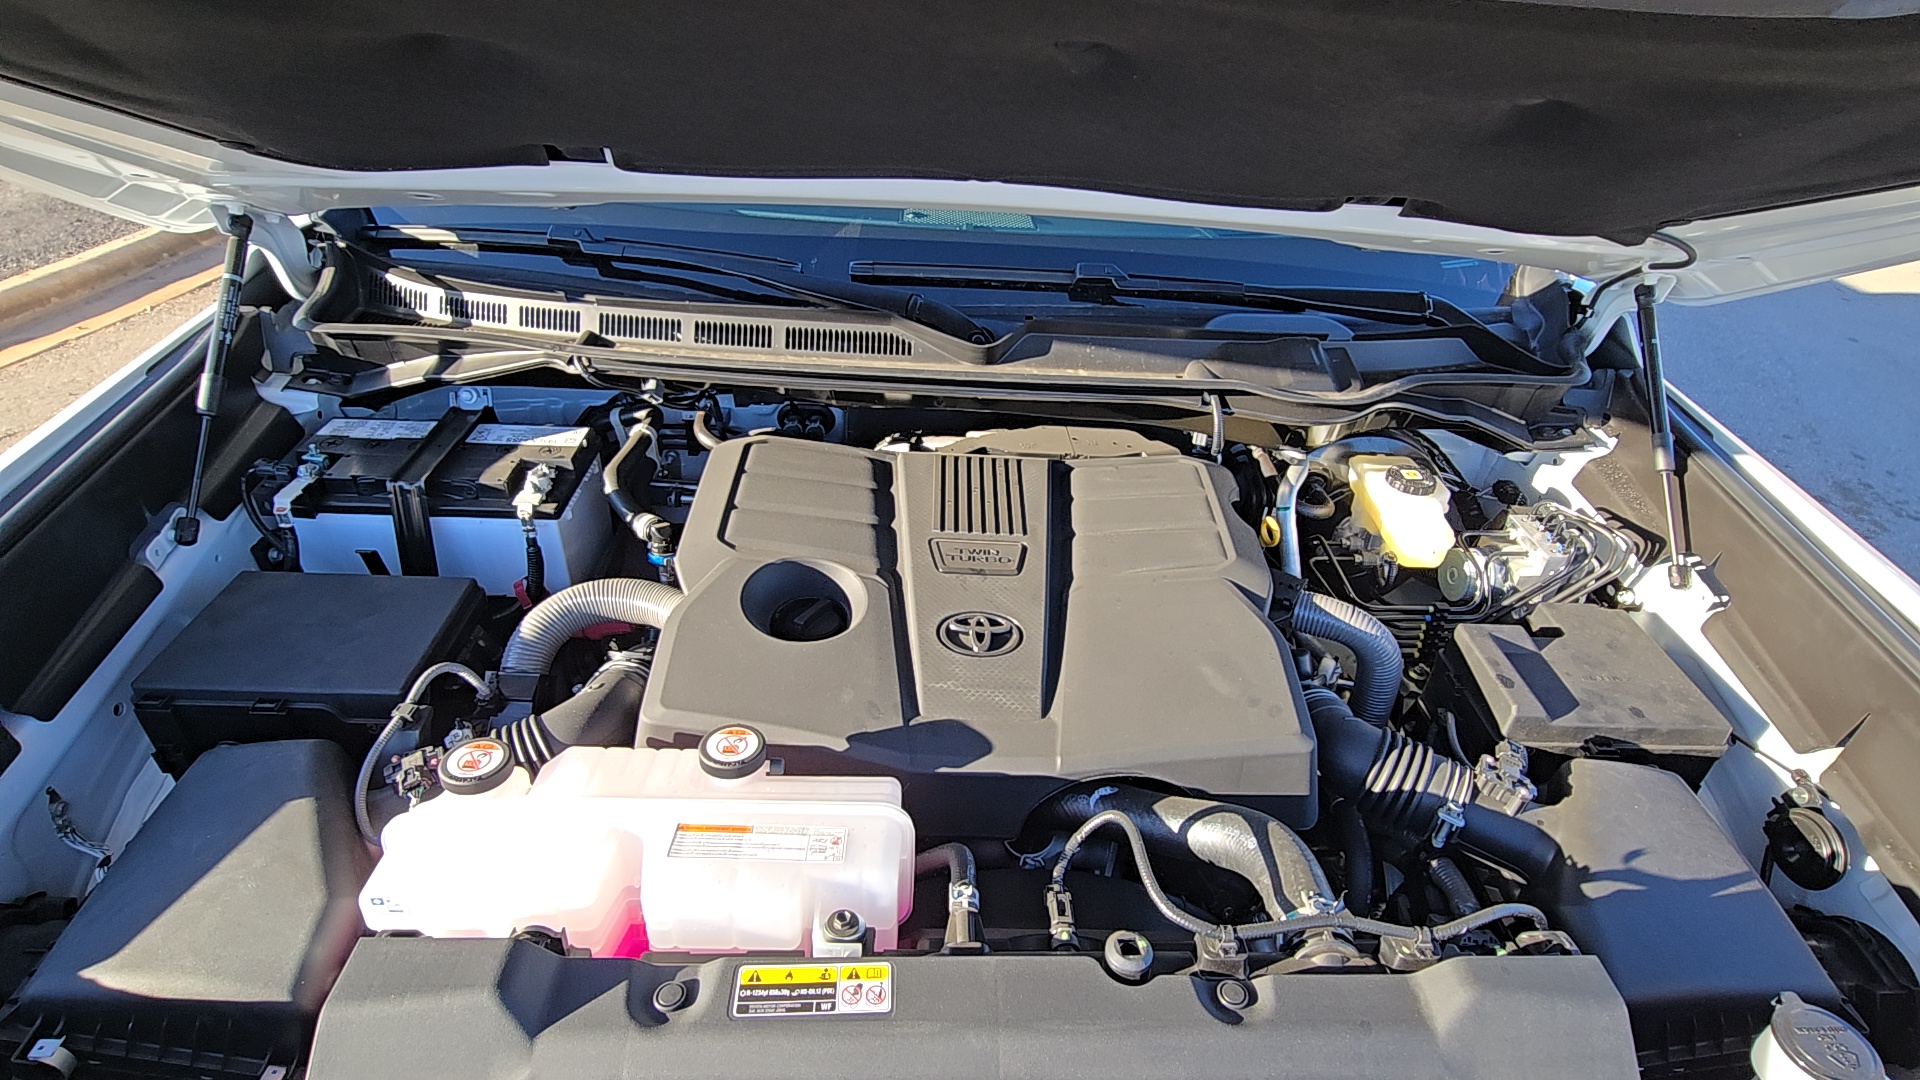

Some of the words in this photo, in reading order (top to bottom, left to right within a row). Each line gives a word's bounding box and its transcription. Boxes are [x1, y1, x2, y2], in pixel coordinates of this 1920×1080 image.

[953, 547, 1000, 556] TWIN
[945, 554, 1013, 563] TURBO
[820, 1002, 833, 1011] WF
